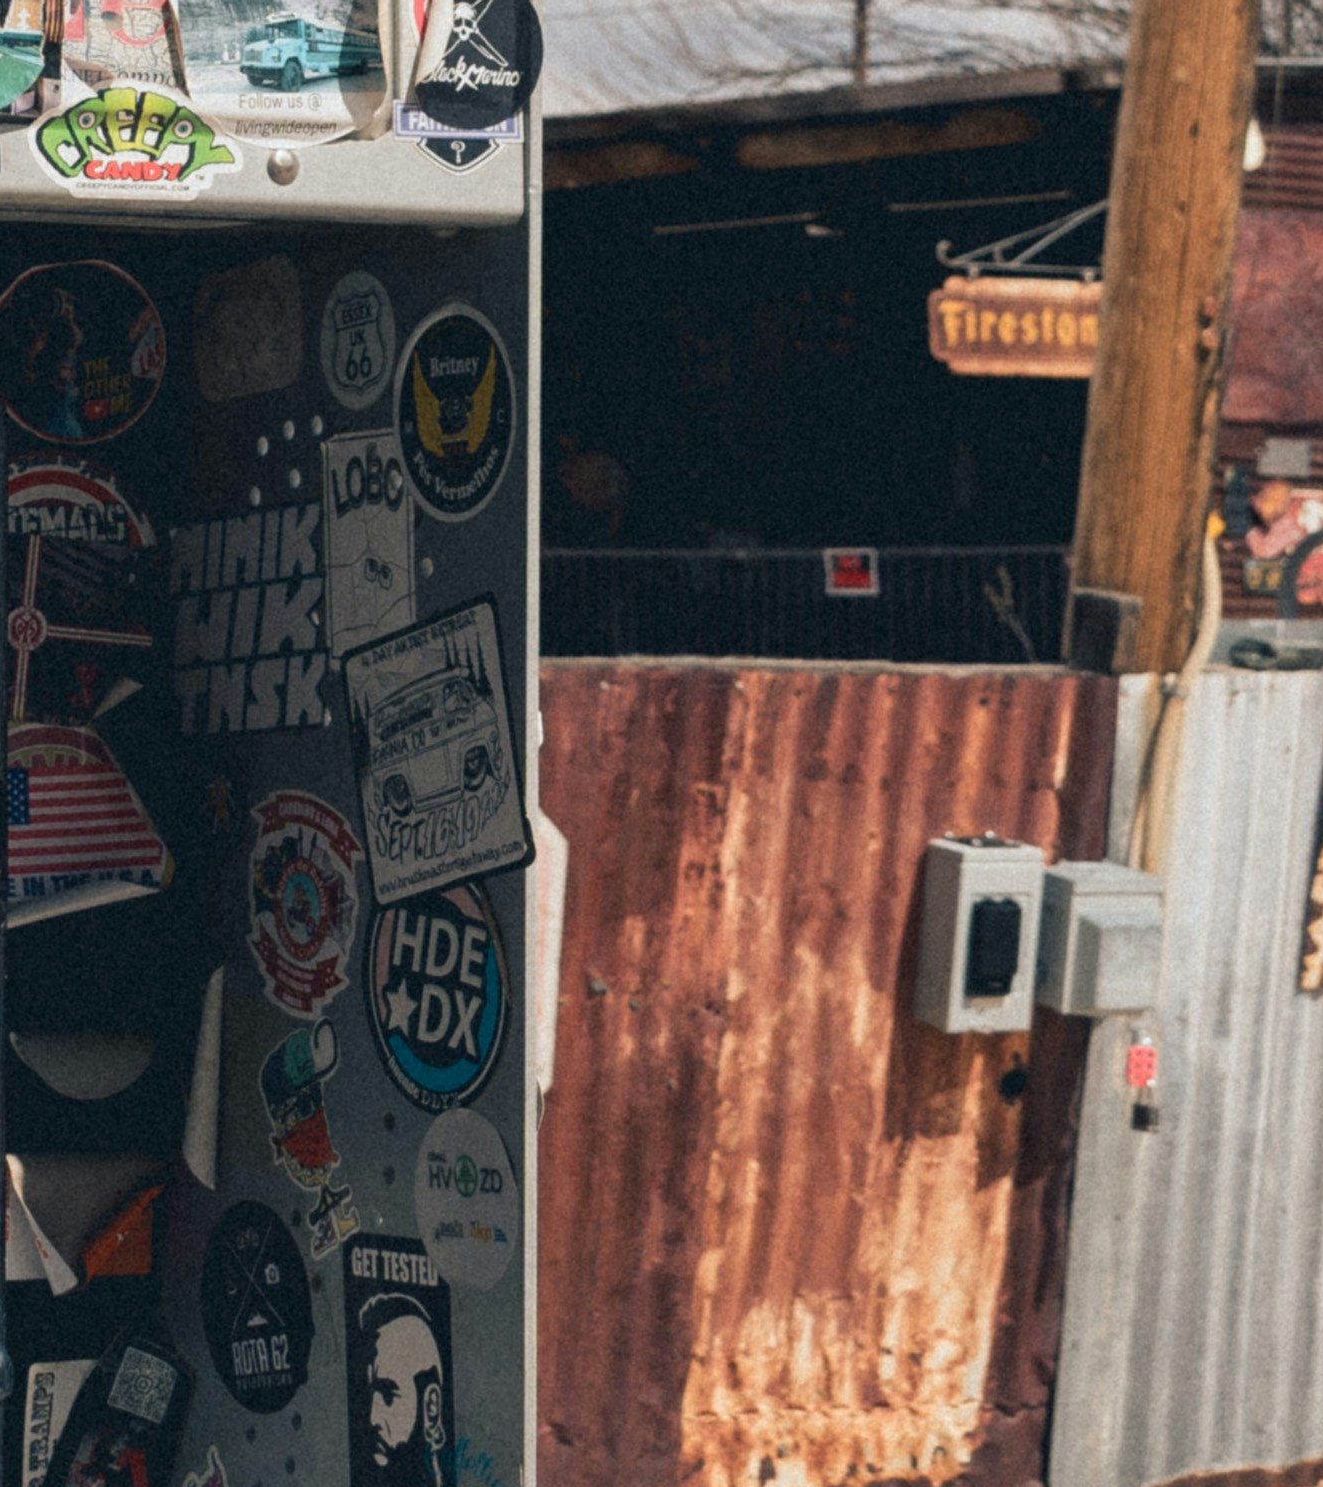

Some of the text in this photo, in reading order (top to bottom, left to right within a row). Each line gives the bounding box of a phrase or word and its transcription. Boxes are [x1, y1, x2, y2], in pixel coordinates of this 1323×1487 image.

[238, 95, 283, 110] Follow
[288, 97, 303, 109] us
[39, 85, 235, 179] CREEPY
[82, 160, 182, 181] CANDY
[340, 306, 371, 325] ESSEX
[350, 330, 365, 346] UK
[344, 348, 373, 381] 66
[429, 353, 480, 378] Britney
[331, 441, 404, 517] LOBO
[23, 877, 45, 896] IN
[392, 909, 487, 988] HDE
[417, 983, 483, 1059] DX
[351, 1247, 439, 1287] GET TESTED
[231, 1332, 291, 1376] ROTA 62
